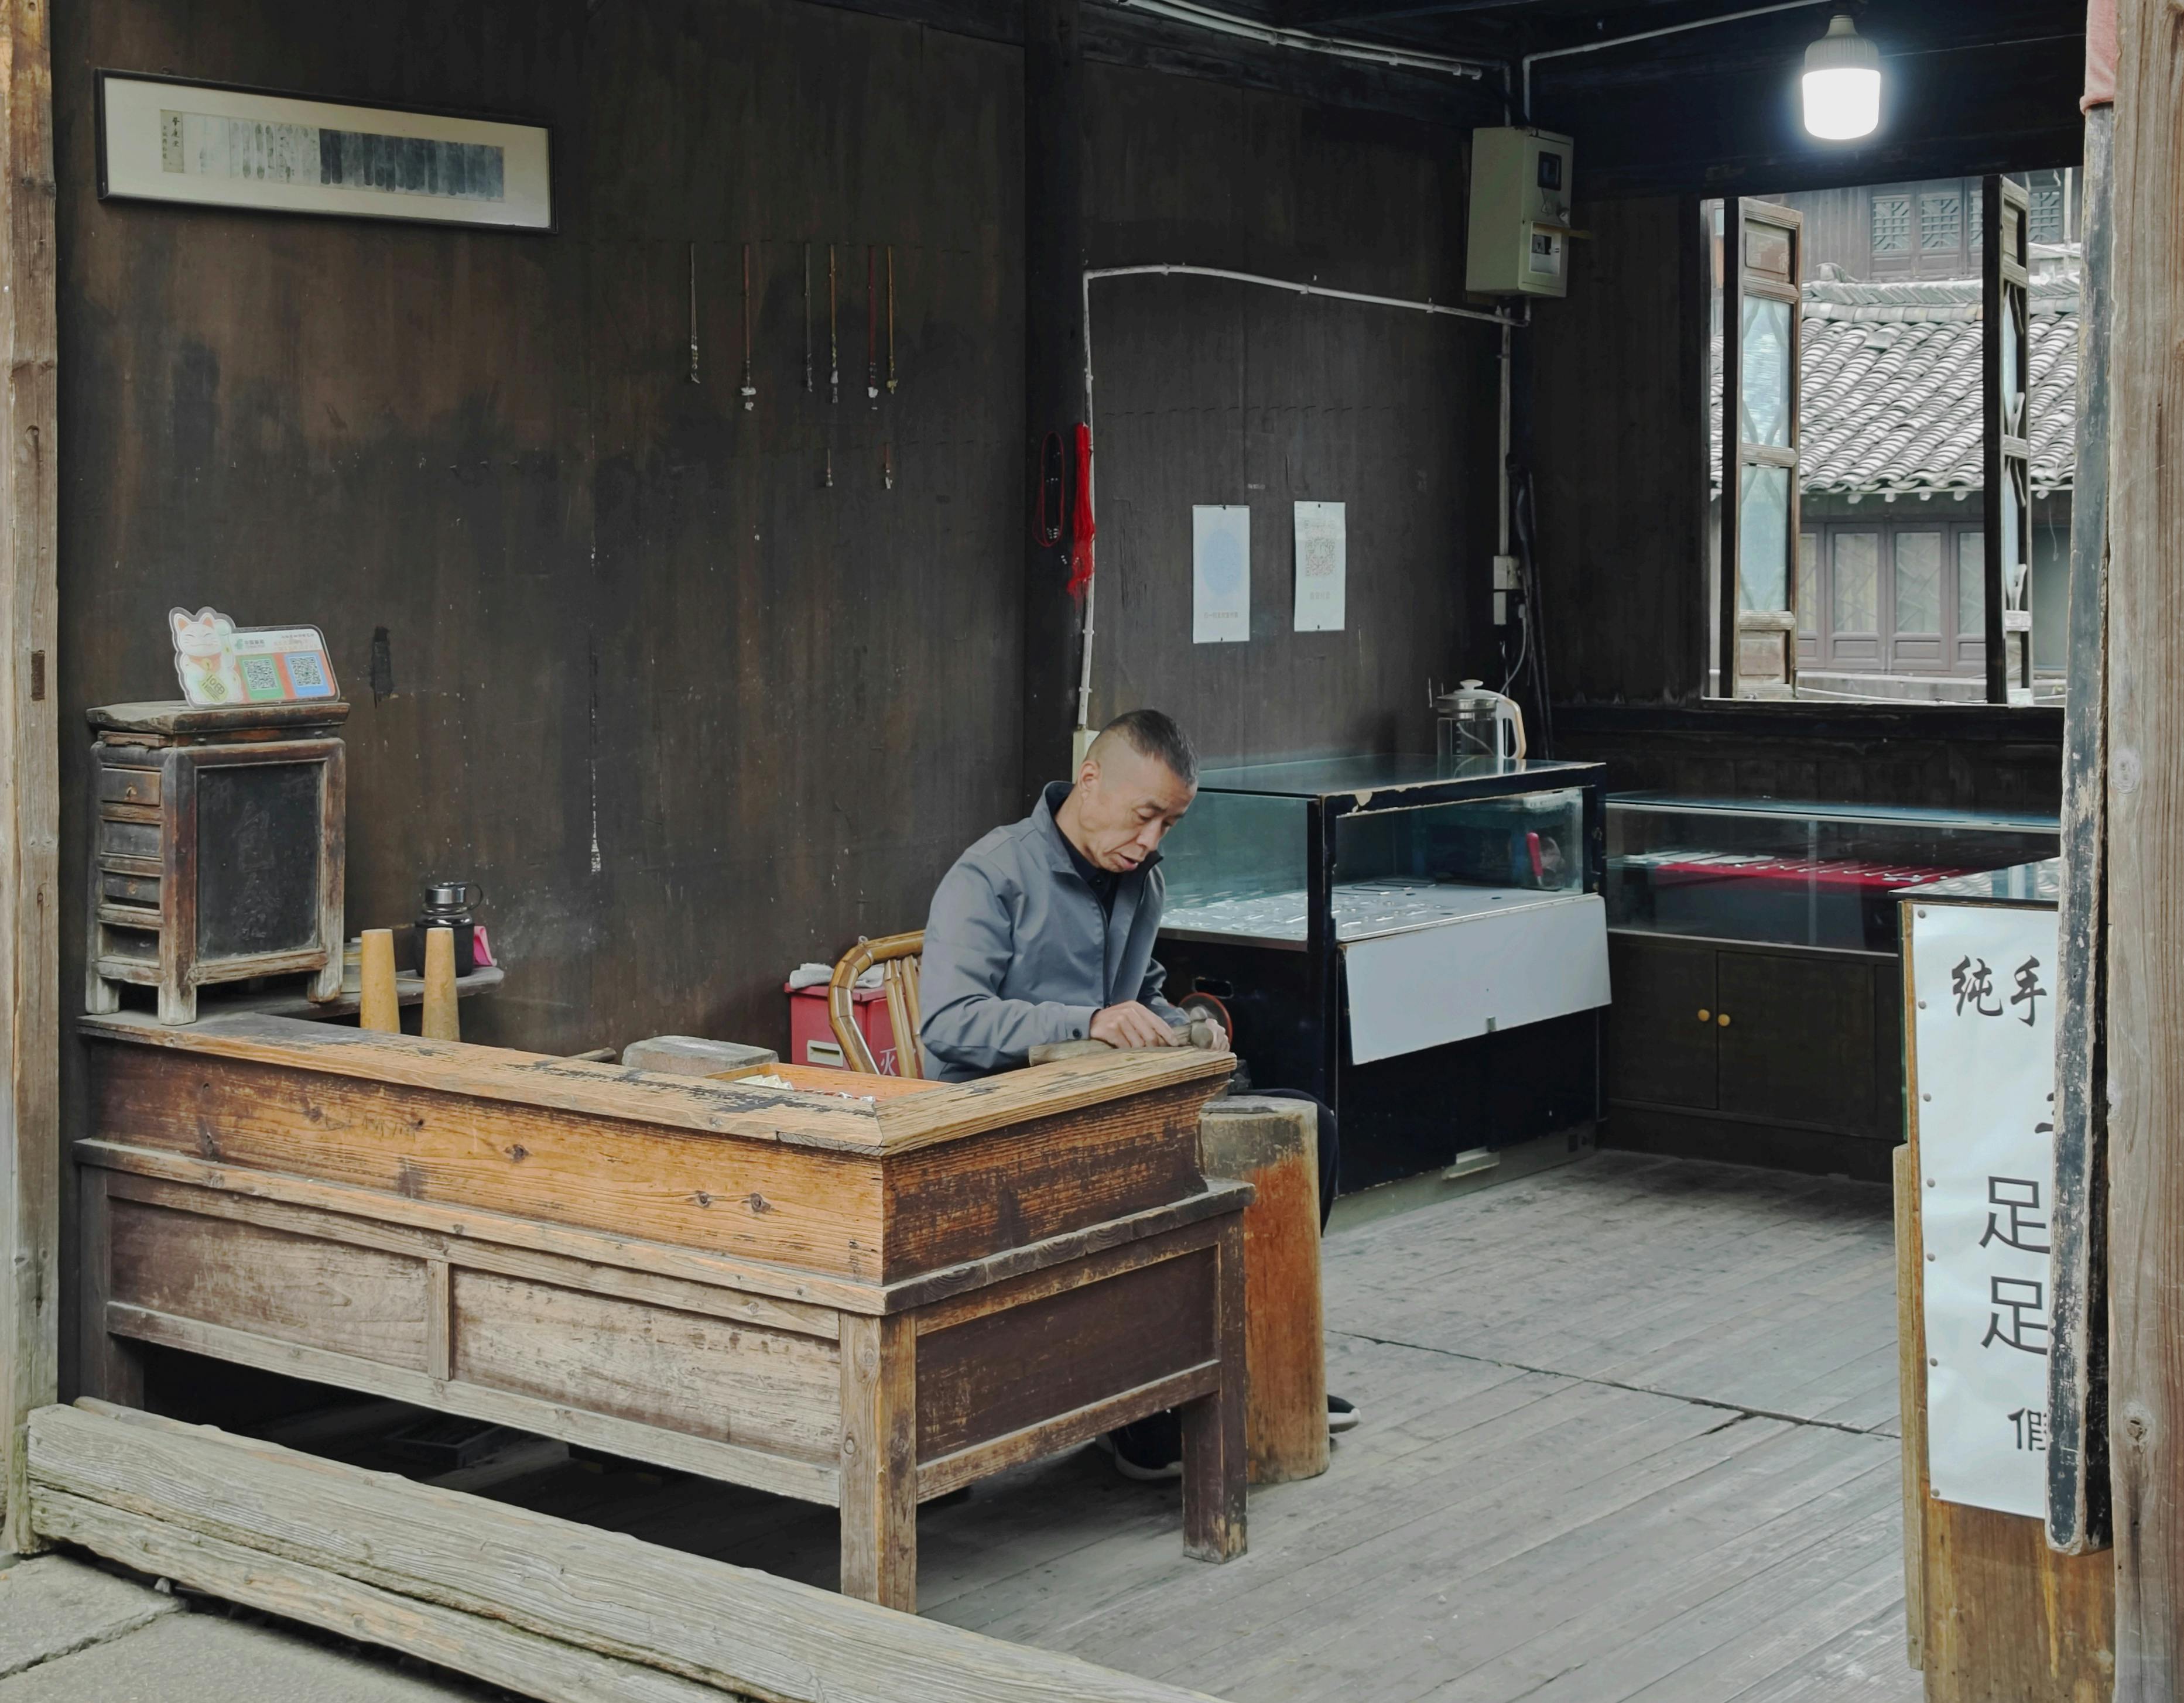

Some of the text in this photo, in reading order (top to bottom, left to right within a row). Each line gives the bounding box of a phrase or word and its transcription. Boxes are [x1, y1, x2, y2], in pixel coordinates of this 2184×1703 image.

[1952, 955, 2047, 1027] 纯手
[879, 1047, 896, 1075] 灭
[1978, 1176, 2050, 1254] 足
[1980, 1276, 2048, 1355] 足
